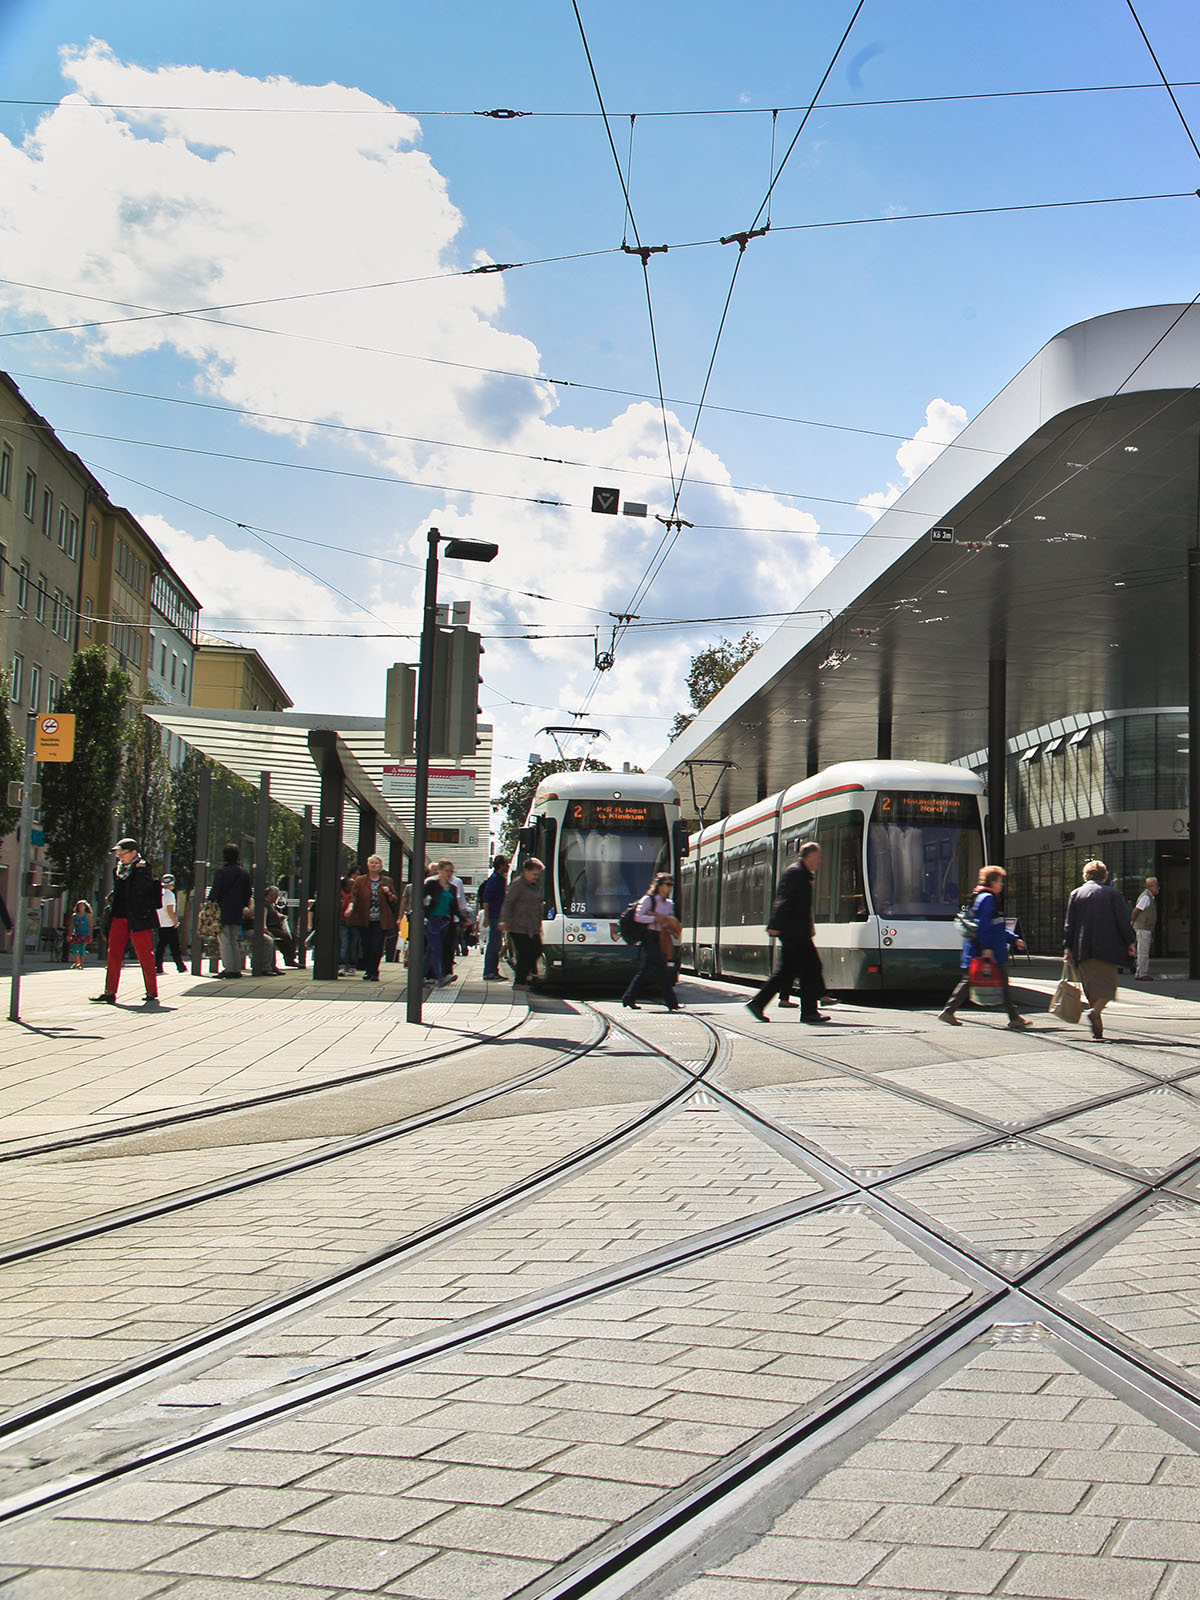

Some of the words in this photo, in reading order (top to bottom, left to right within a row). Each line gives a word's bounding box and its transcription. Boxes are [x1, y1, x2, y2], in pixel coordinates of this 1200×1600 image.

[882, 797, 891, 811] 2
[574, 805, 582, 818] 2
[570, 902, 586, 912] 875
